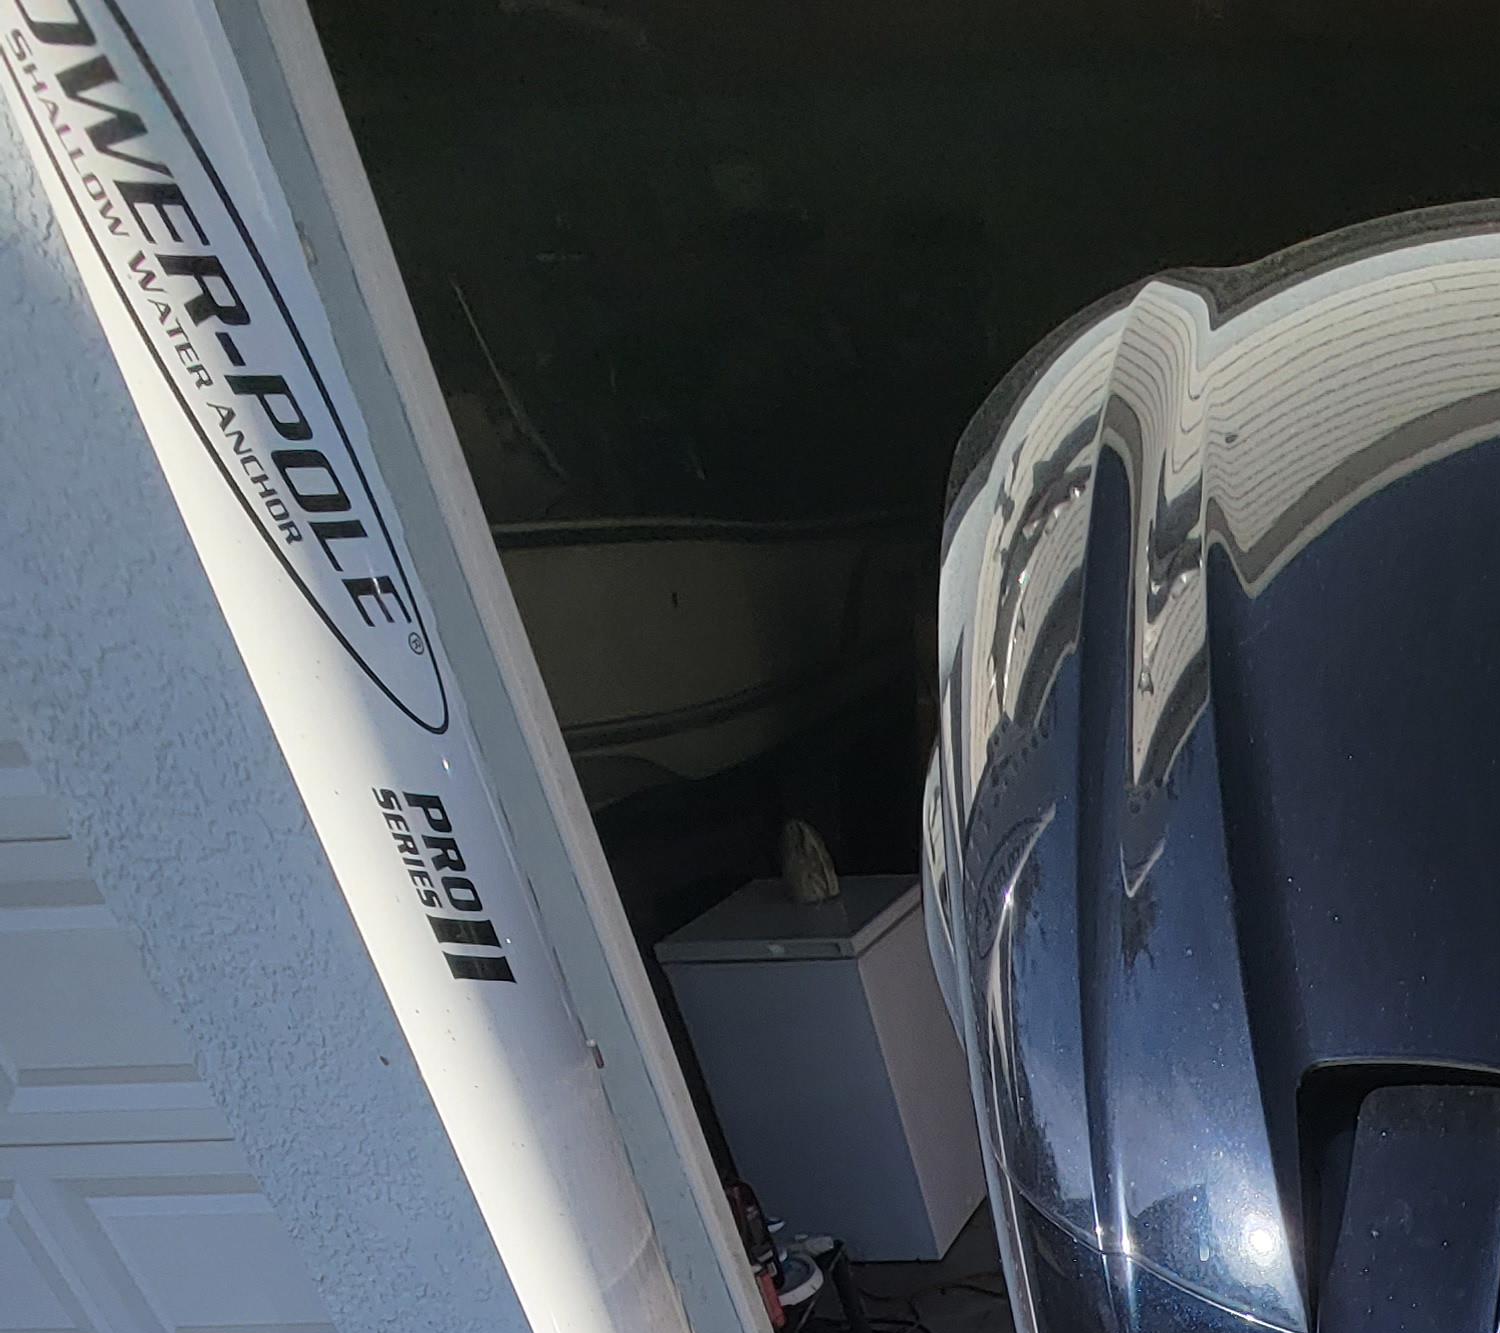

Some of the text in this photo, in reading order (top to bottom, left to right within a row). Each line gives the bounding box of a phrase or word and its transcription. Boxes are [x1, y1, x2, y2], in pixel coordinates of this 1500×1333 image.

[5, 29, 303, 545] SHALLOW WATER ANCHOR
[372, 787, 442, 909] SERIES
[403, 791, 483, 912] PRO
